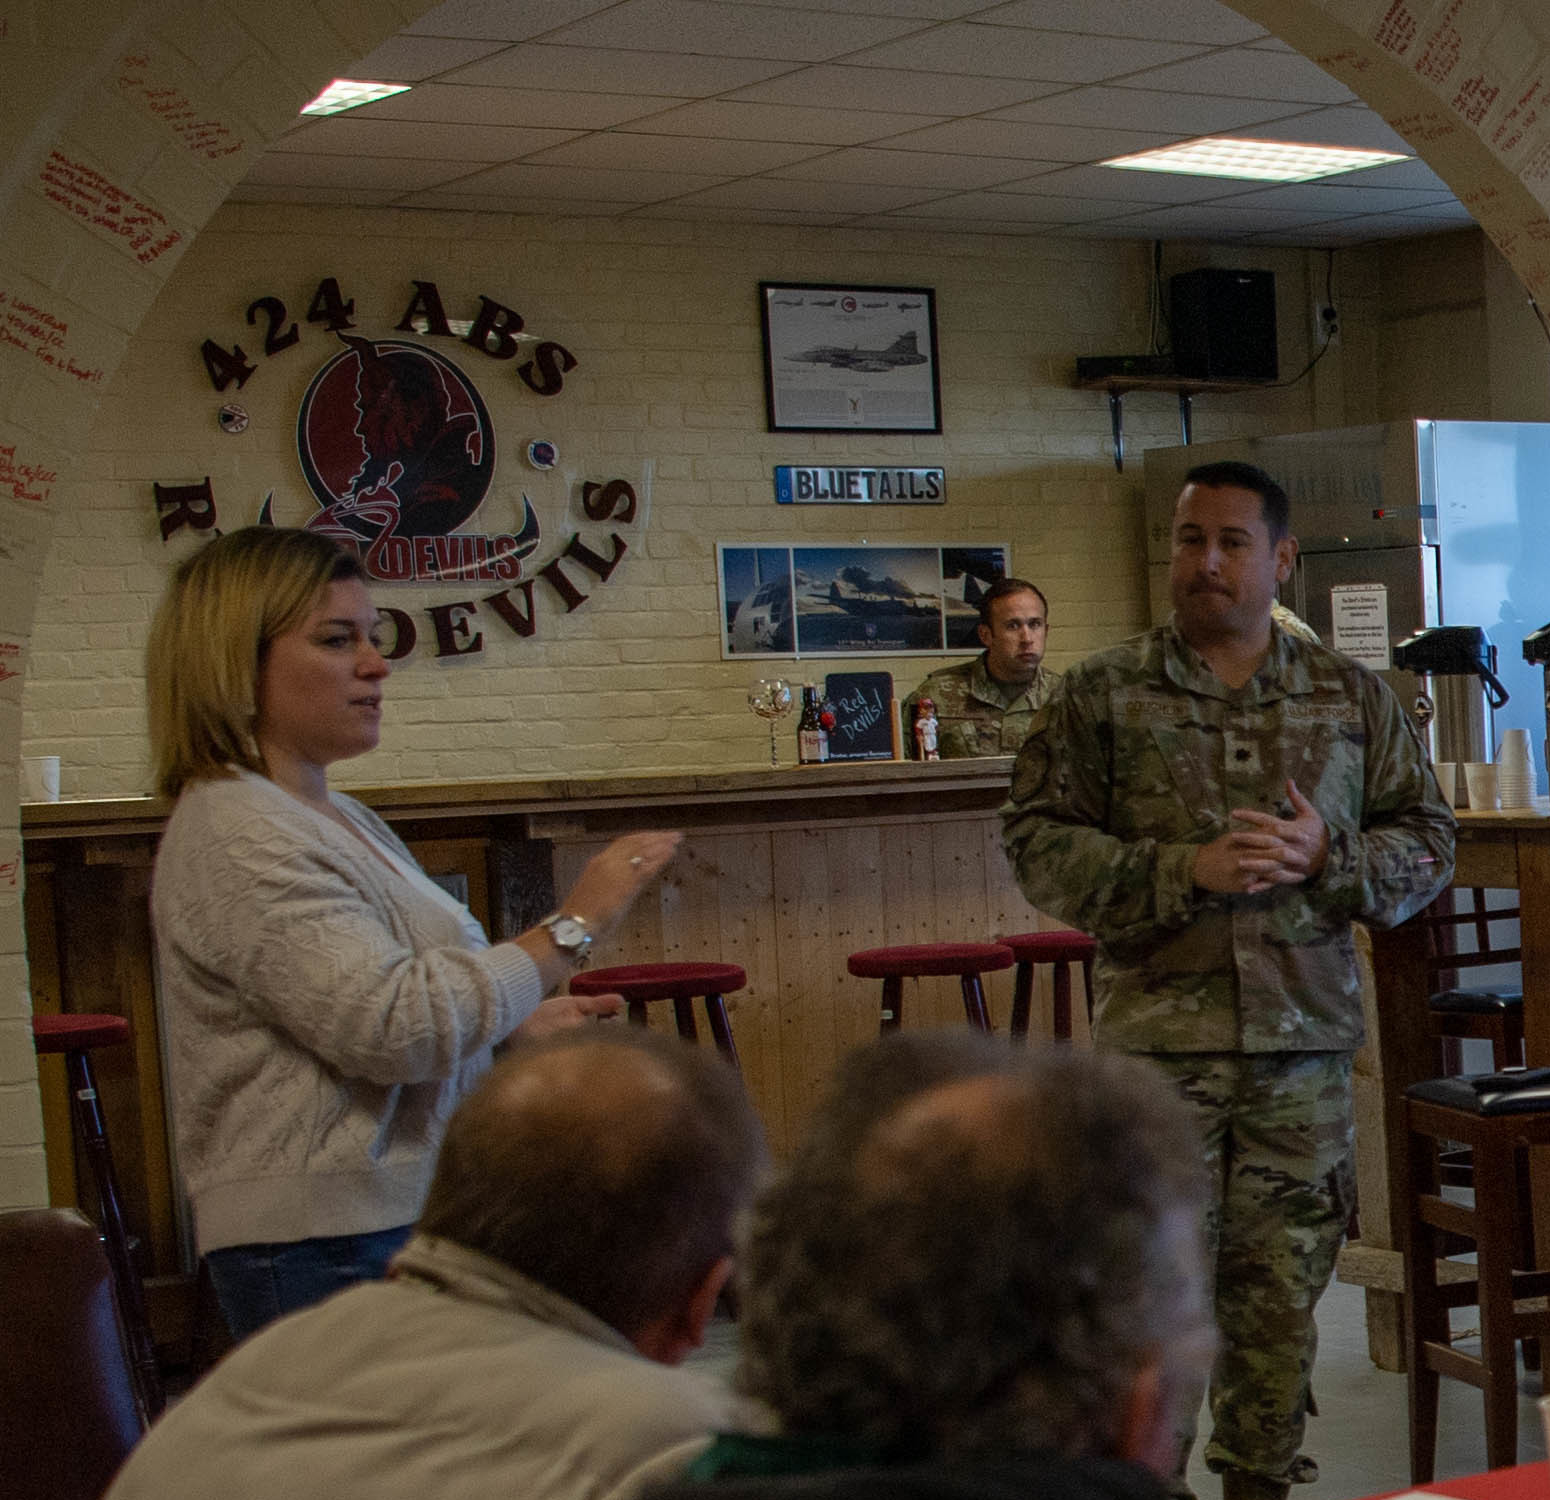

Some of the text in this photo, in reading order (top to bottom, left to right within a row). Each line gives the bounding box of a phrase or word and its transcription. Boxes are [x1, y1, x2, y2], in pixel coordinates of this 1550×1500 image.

[201, 277, 578, 397] 424 ABS
[796, 469, 940, 500] BLUETAILS
[378, 478, 638, 661] DEVILS
[384, 535, 523, 583] DEVILS
[839, 687, 868, 714] Red
